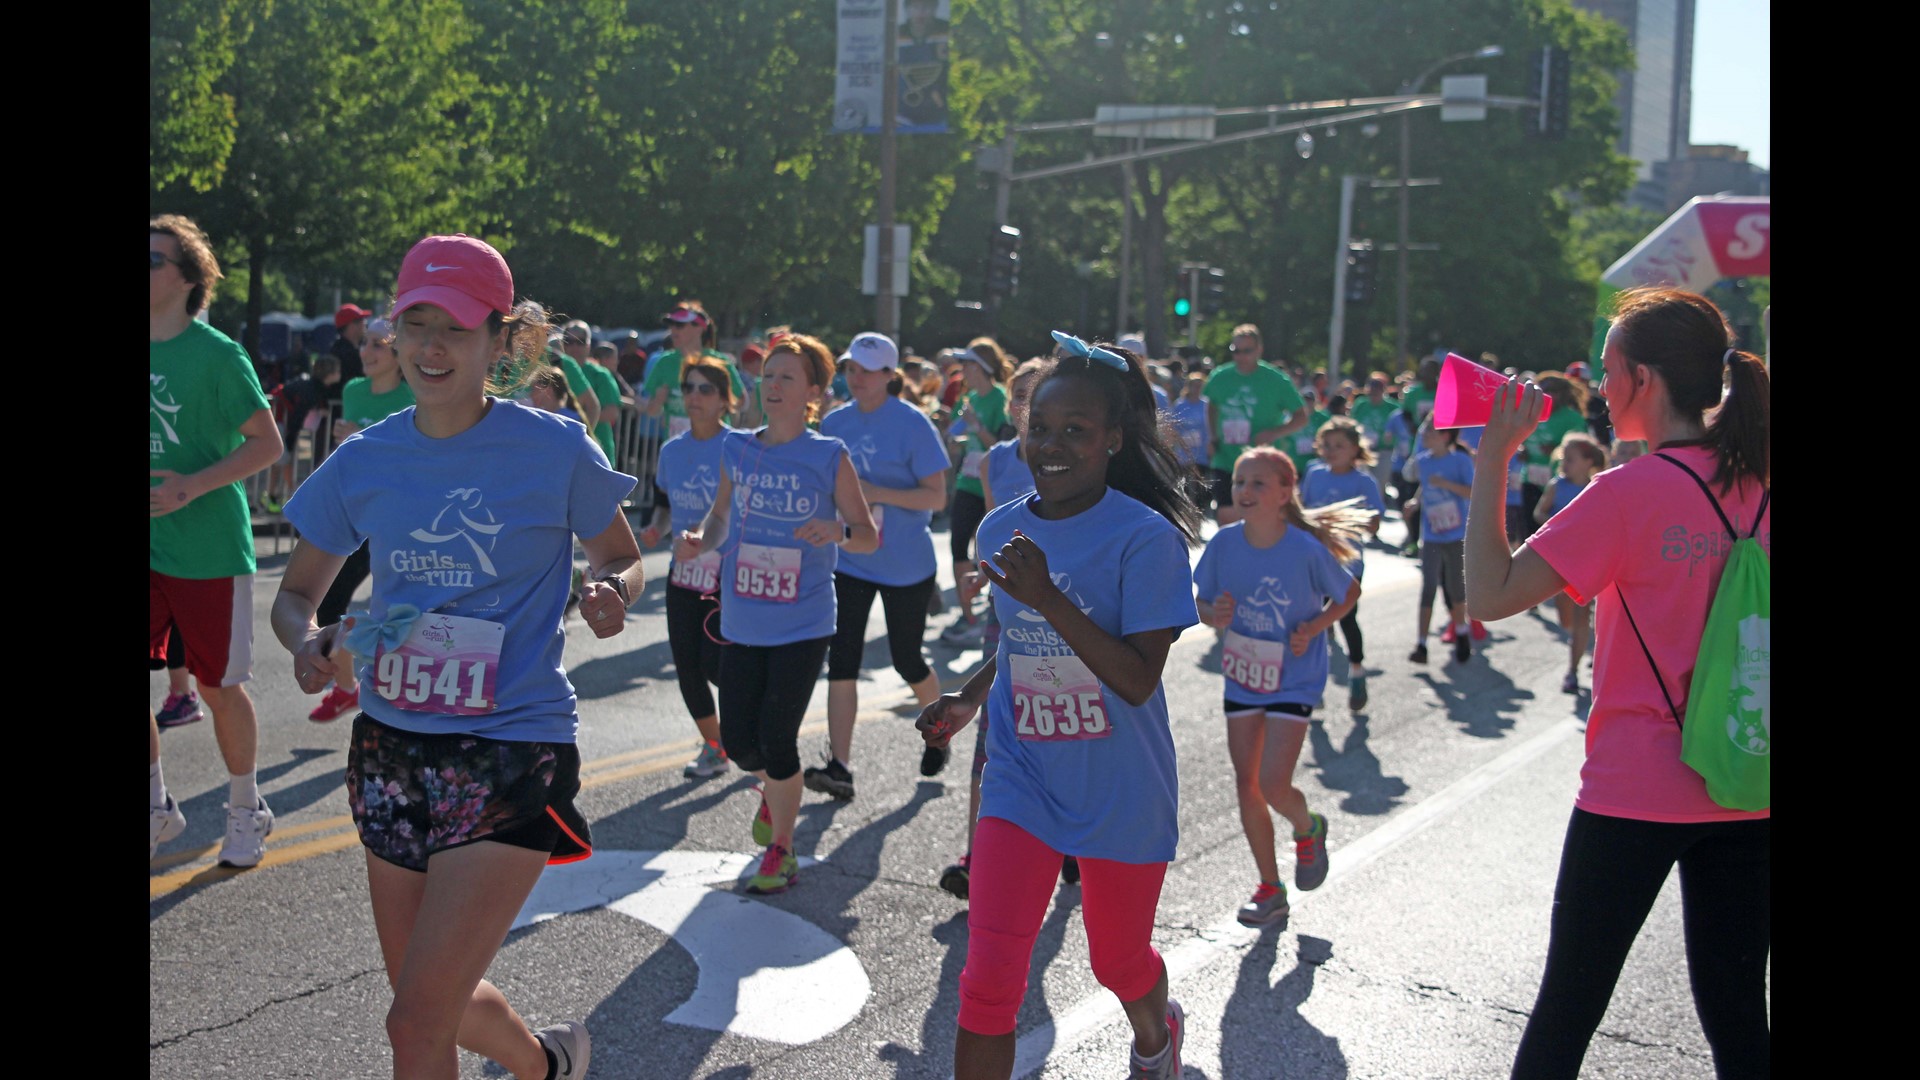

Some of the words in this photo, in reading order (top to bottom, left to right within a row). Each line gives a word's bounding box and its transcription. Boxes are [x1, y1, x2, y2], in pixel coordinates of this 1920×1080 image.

[732, 466, 800, 491] heart
[751, 491, 811, 514] sle
[390, 549, 456, 573] Girls
[456, 562, 473, 570] on
[405, 573, 426, 582] the
[425, 570, 474, 588] run
[672, 562, 717, 589] 9506
[737, 568, 798, 599] 9533
[422, 629, 441, 638] Girls
[1006, 627, 1059, 646] Girls
[1025, 644, 1037, 655] the
[377, 653, 488, 709] 9541
[1223, 653, 1281, 691] 2699
[1014, 692, 1106, 736] 2635
